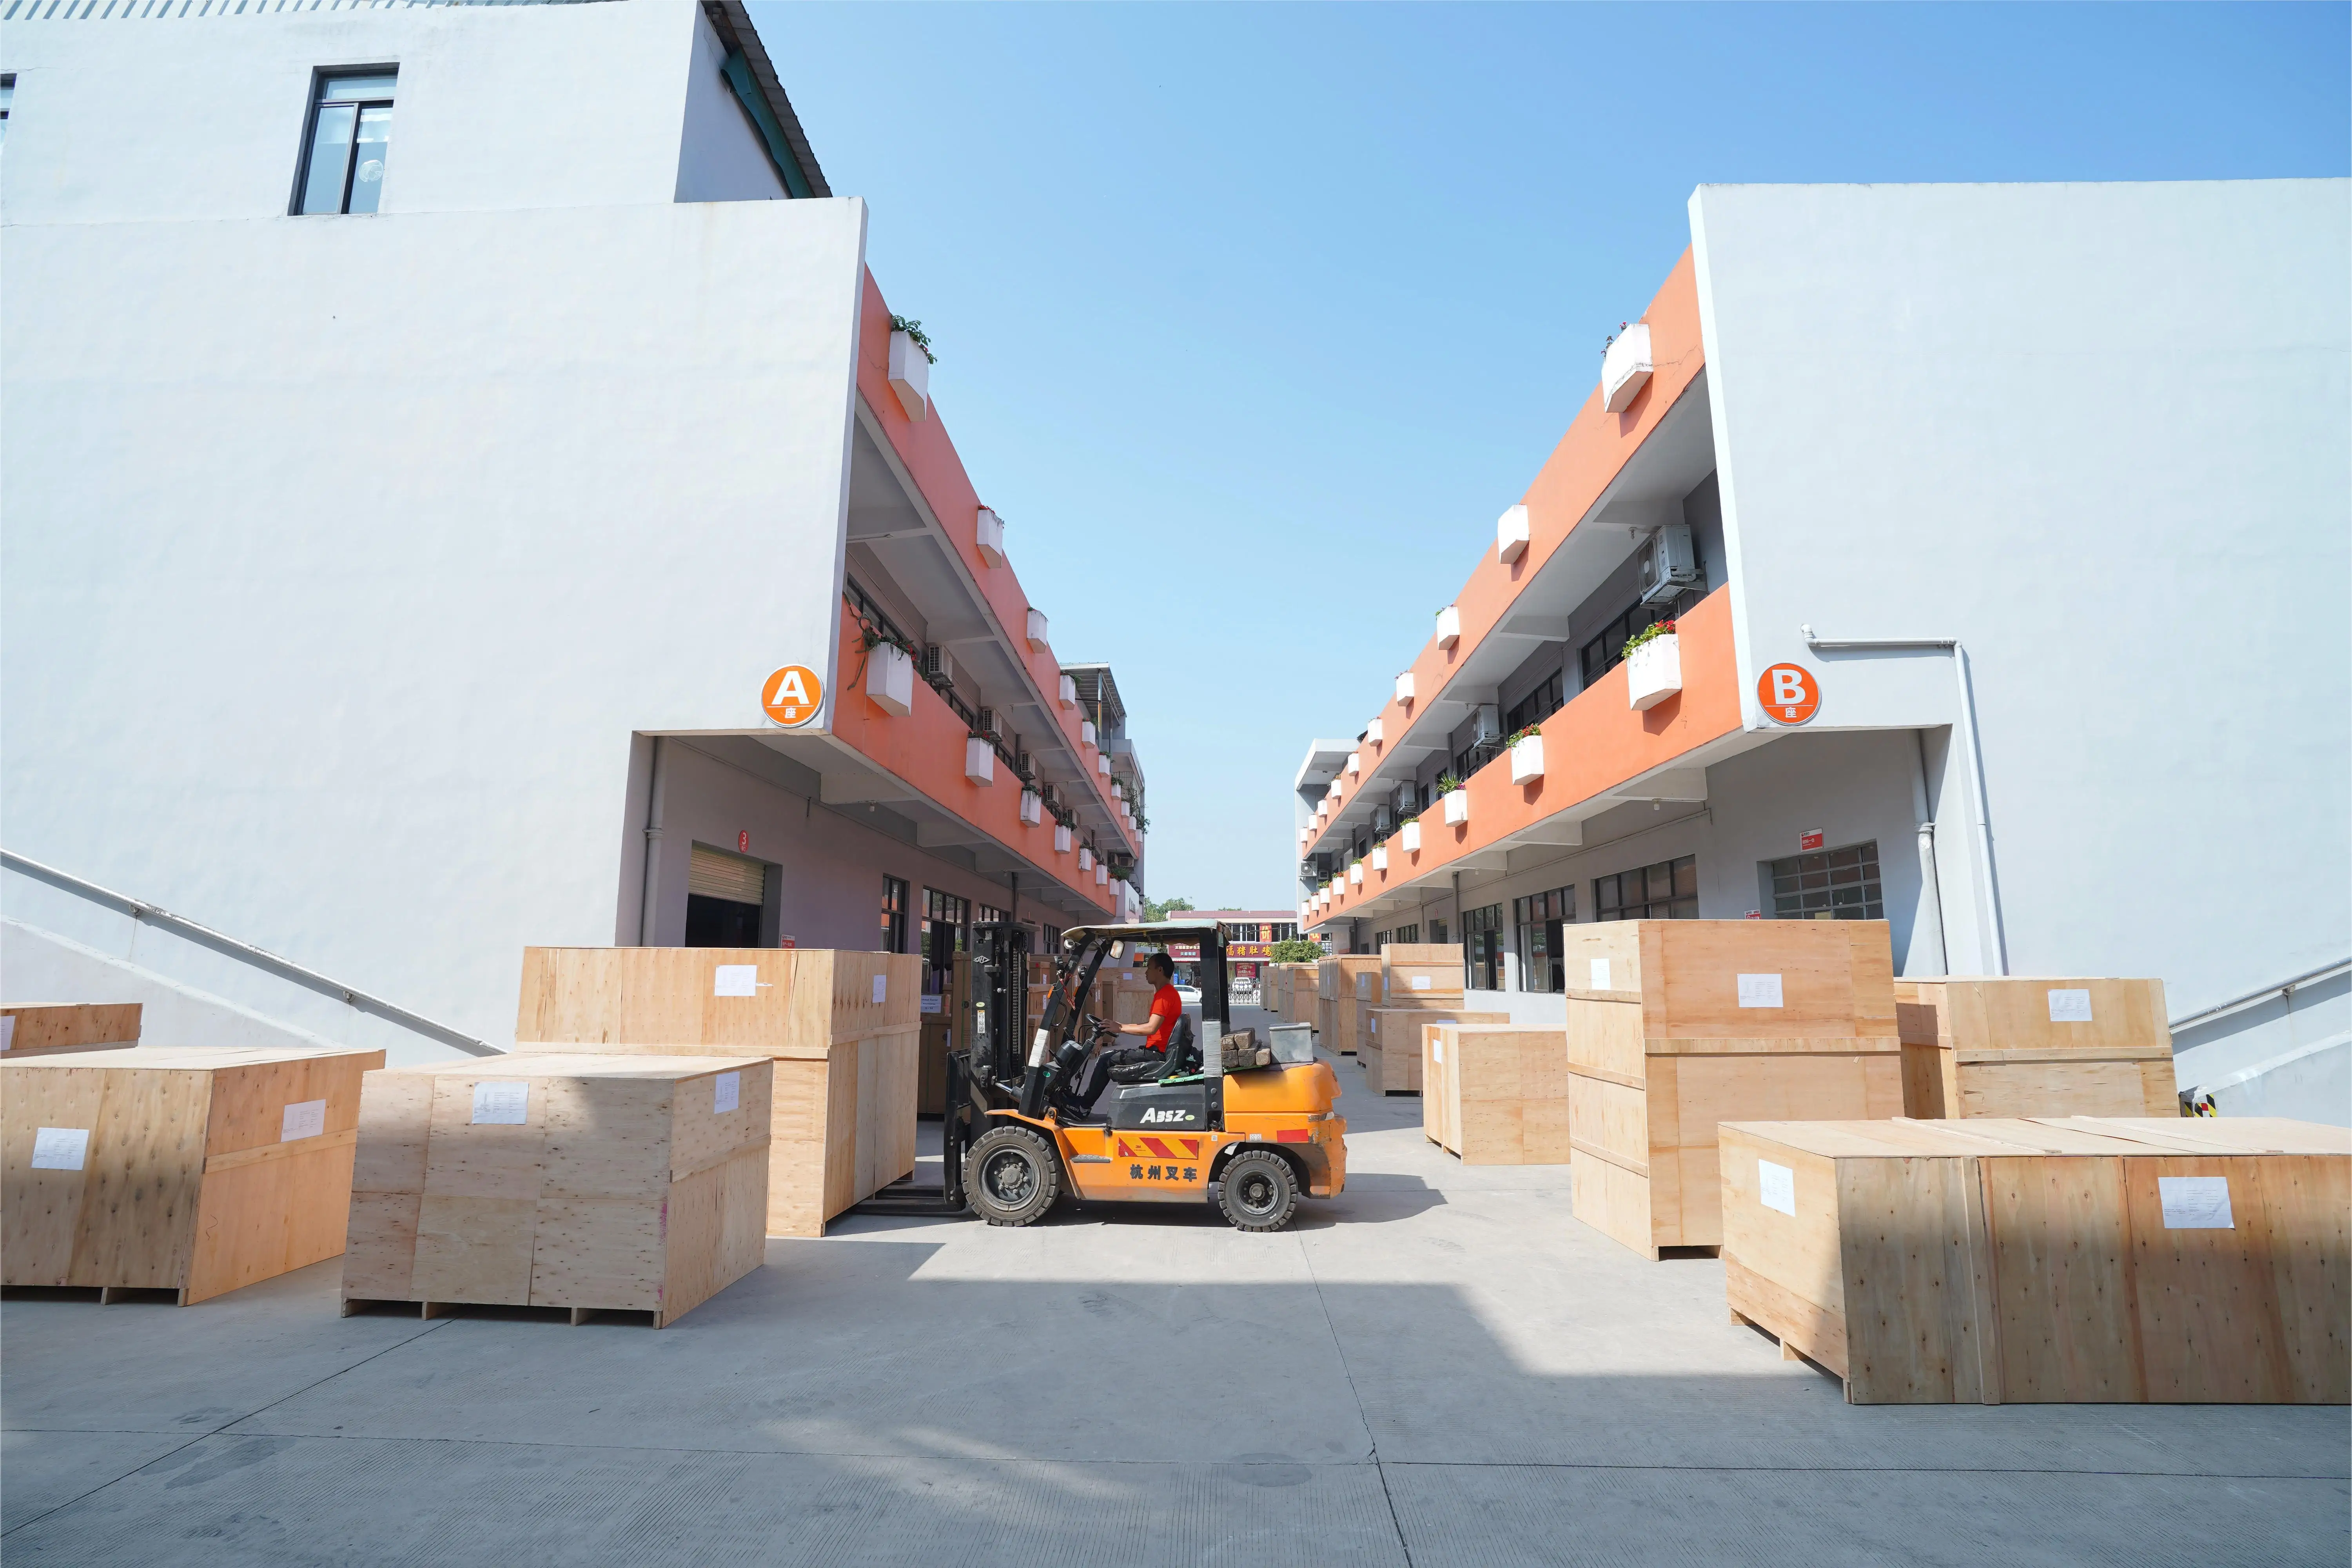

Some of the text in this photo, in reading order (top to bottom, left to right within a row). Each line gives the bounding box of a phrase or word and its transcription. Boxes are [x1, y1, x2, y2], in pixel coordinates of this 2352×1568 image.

[771, 670, 809, 705] A
[1772, 669, 1806, 704] B
[784, 707, 797, 719] 座
[1785, 706, 1797, 718] 座
[742, 832, 746, 845] 3
[1261, 926, 1270, 940] 价
[1226, 945, 1272, 956] 福猪肚鸡
[1130, 1163, 1197, 1182] 杭州叉车
